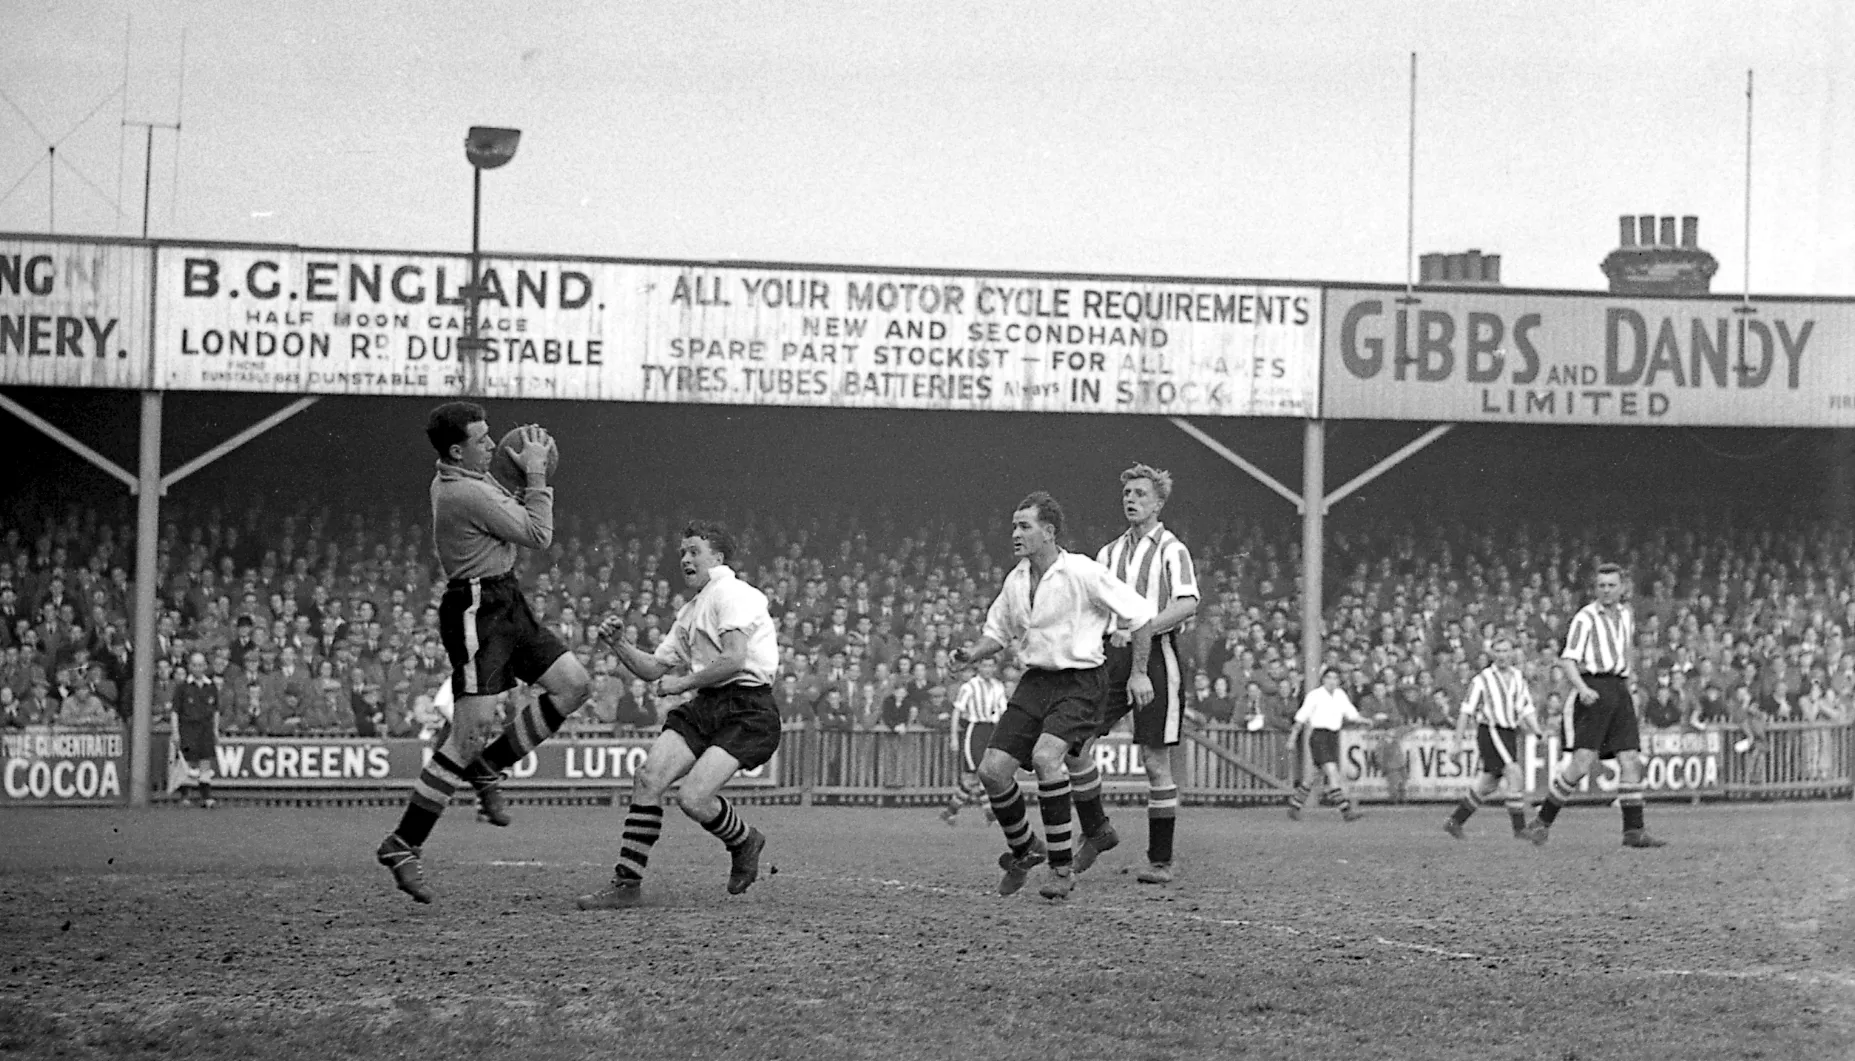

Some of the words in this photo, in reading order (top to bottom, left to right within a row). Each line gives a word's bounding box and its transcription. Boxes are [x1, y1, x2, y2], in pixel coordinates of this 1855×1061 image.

[671, 274, 732, 307] ALL
[741, 278, 830, 309] YOUR
[848, 281, 965, 314] MOTOR
[977, 286, 1071, 319] CYCLE
[1083, 289, 1310, 326] REQUIREMENTS
[0, 314, 127, 358] NERY.
[246, 310, 314, 326] HALF
[334, 312, 409, 328] MOON
[802, 316, 868, 338] NEW
[885, 320, 947, 341] AND
[967, 322, 1169, 348] SECONDHAND
[181, 328, 330, 359] LONDON
[669, 337, 766, 361] SPARE
[781, 342, 860, 364] PART
[873, 345, 1009, 369] STOCKIST
[1052, 350, 1106, 372] FOR
[1121, 352, 1174, 376] ALL
[1340, 299, 1542, 385] GIBBS
[1546, 364, 1599, 387] AND
[1604, 306, 1817, 391] DANDY
[308, 371, 429, 386] DUNSTABLE
[843, 371, 993, 401] BATTERIES
[1004, 381, 1060, 398] Always
[1071, 377, 1101, 404] IN
[1116, 380, 1226, 407] STOCK
[1482, 388, 1671, 418] LIMITED
[4, 758, 120, 798] COCOA
[565, 747, 650, 778] LUTO
